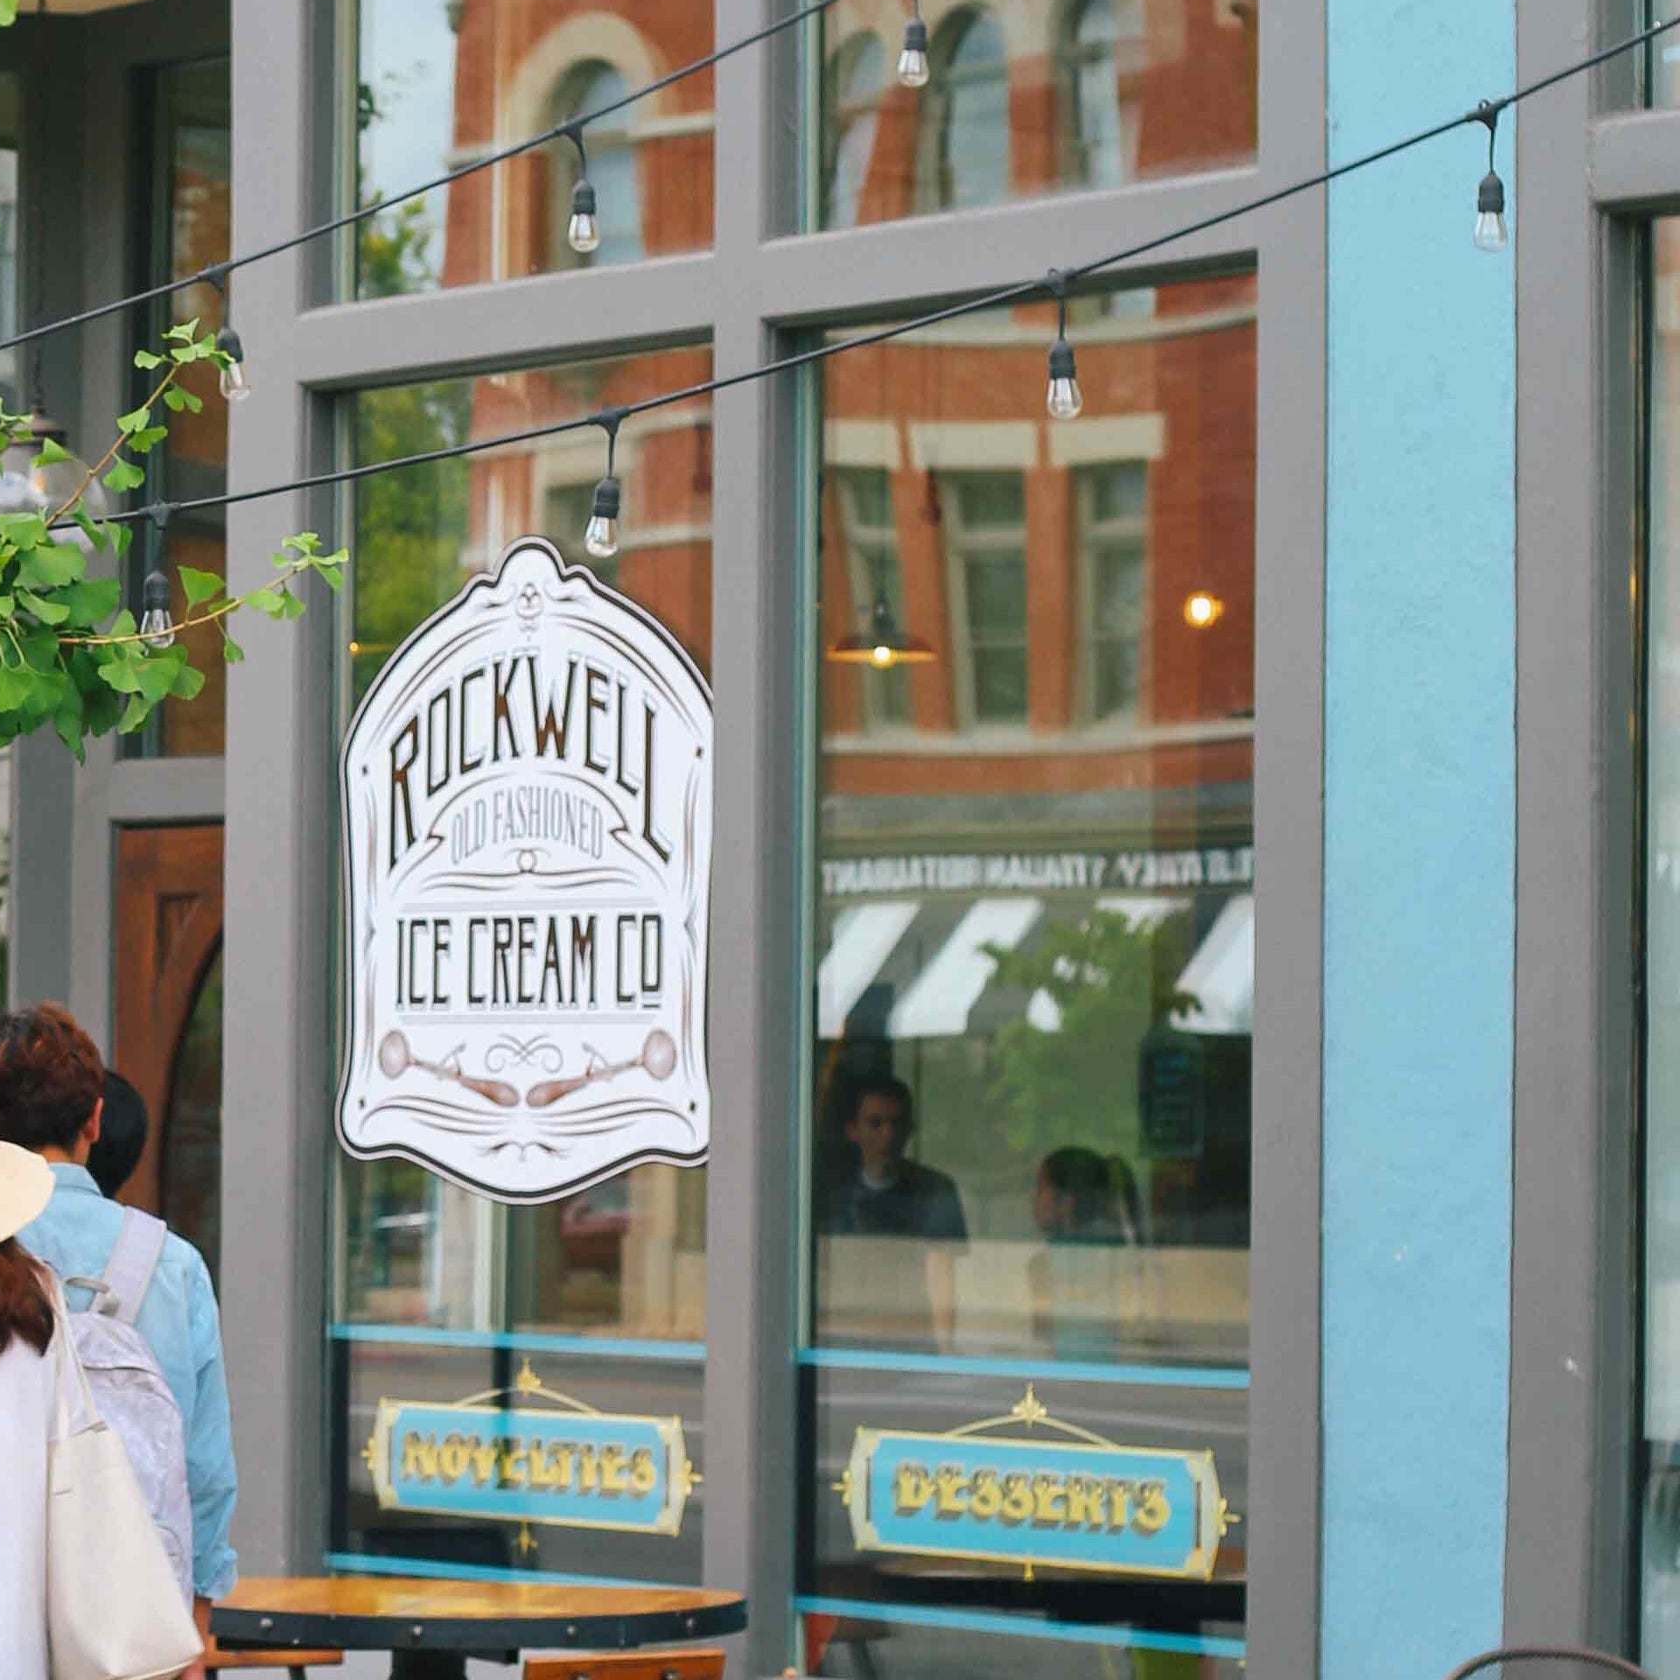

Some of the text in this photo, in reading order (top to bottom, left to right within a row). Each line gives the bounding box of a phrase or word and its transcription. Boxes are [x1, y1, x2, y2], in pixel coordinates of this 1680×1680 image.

[388, 651, 673, 873] ROCKWELL
[450, 784, 605, 866] OLD FASHIONED
[394, 911, 665, 1011] ICE CREAM CO
[402, 1430, 658, 1499] NOVELTIES
[894, 1461, 1171, 1536] DESSERTS
